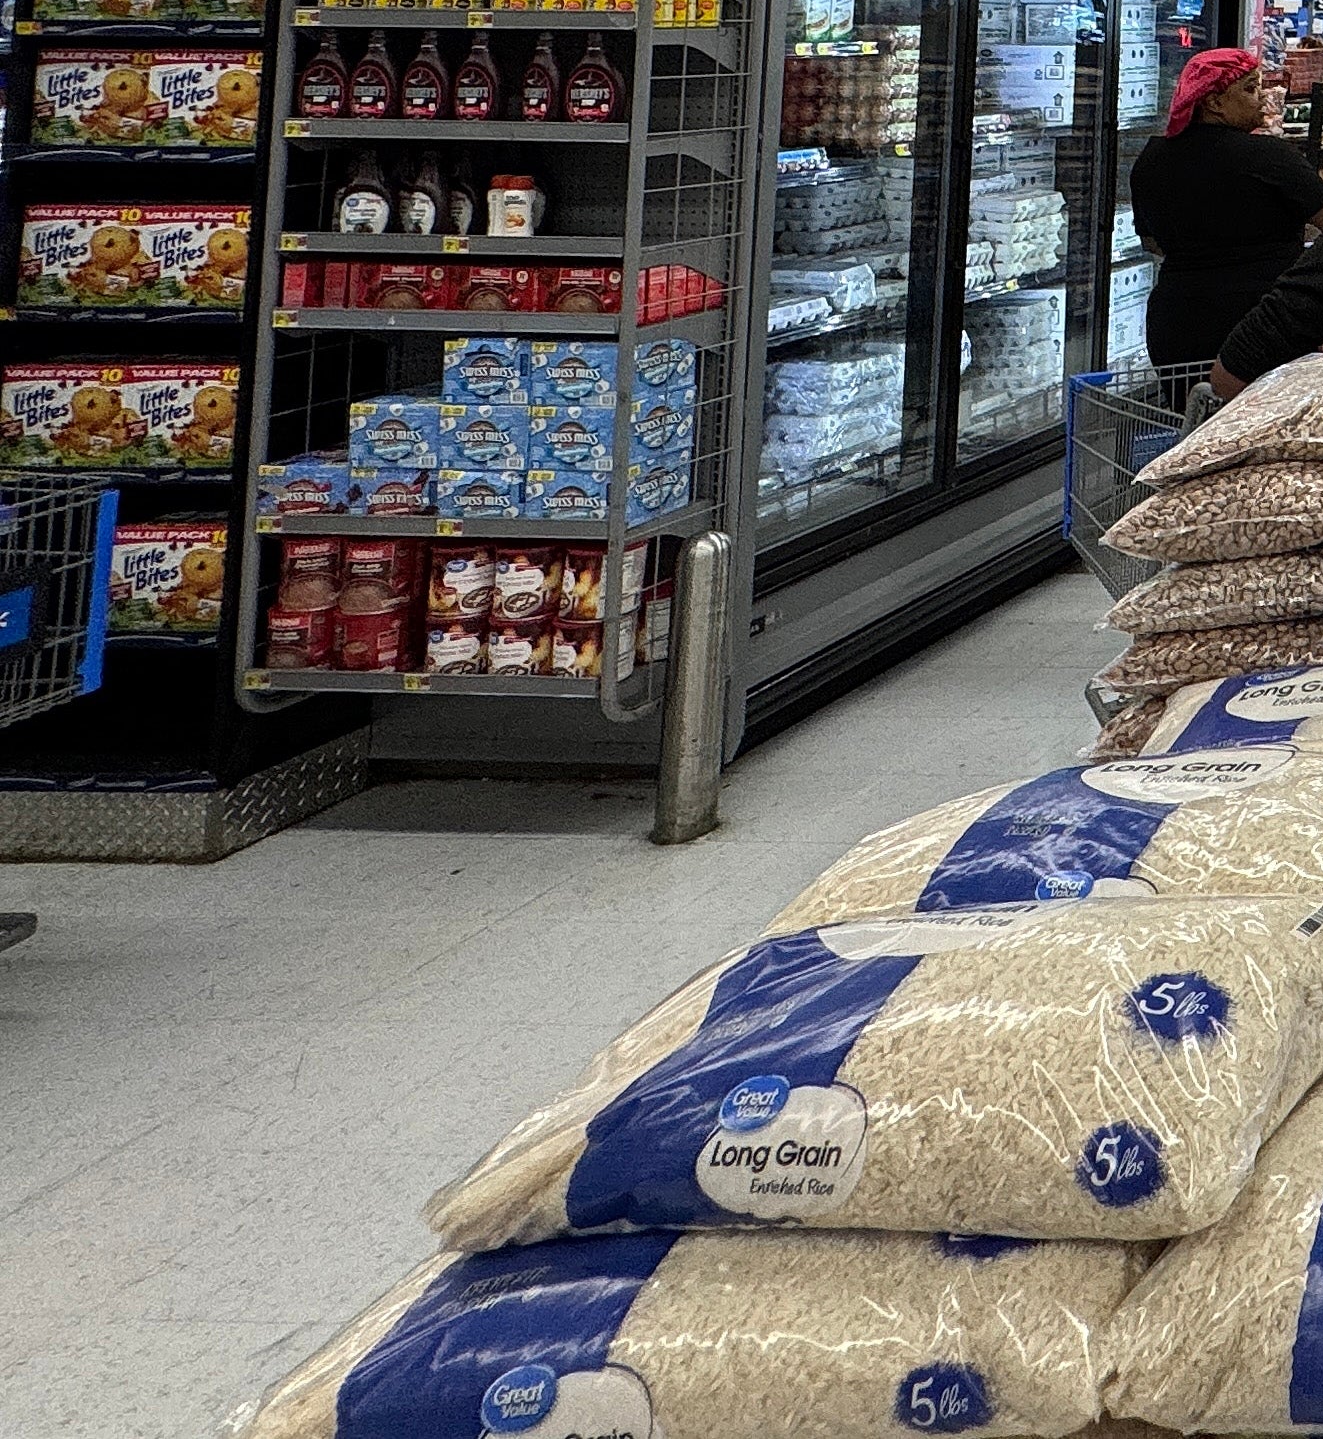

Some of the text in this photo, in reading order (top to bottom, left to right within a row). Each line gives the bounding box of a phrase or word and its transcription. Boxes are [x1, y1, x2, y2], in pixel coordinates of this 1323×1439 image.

[48, 69, 88, 96] Little
[161, 69, 202, 98] Little
[58, 85, 101, 108] Bites
[172, 86, 215, 109] Bites
[35, 227, 75, 255] Little
[152, 229, 193, 257] Little
[45, 244, 88, 266] Bites
[164, 245, 206, 269] Bites
[13, 386, 55, 414] Little
[140, 386, 179, 414] Little
[26, 404, 70, 427] Bites
[151, 404, 192, 427] Bites
[124, 549, 166, 578] Little
[135, 567, 179, 590] Bites
[1239, 679, 1300, 704] Long
[733, 1088, 779, 1106] Great
[710, 1140, 842, 1173] Long Grain
[493, 1381, 546, 1406] Great
